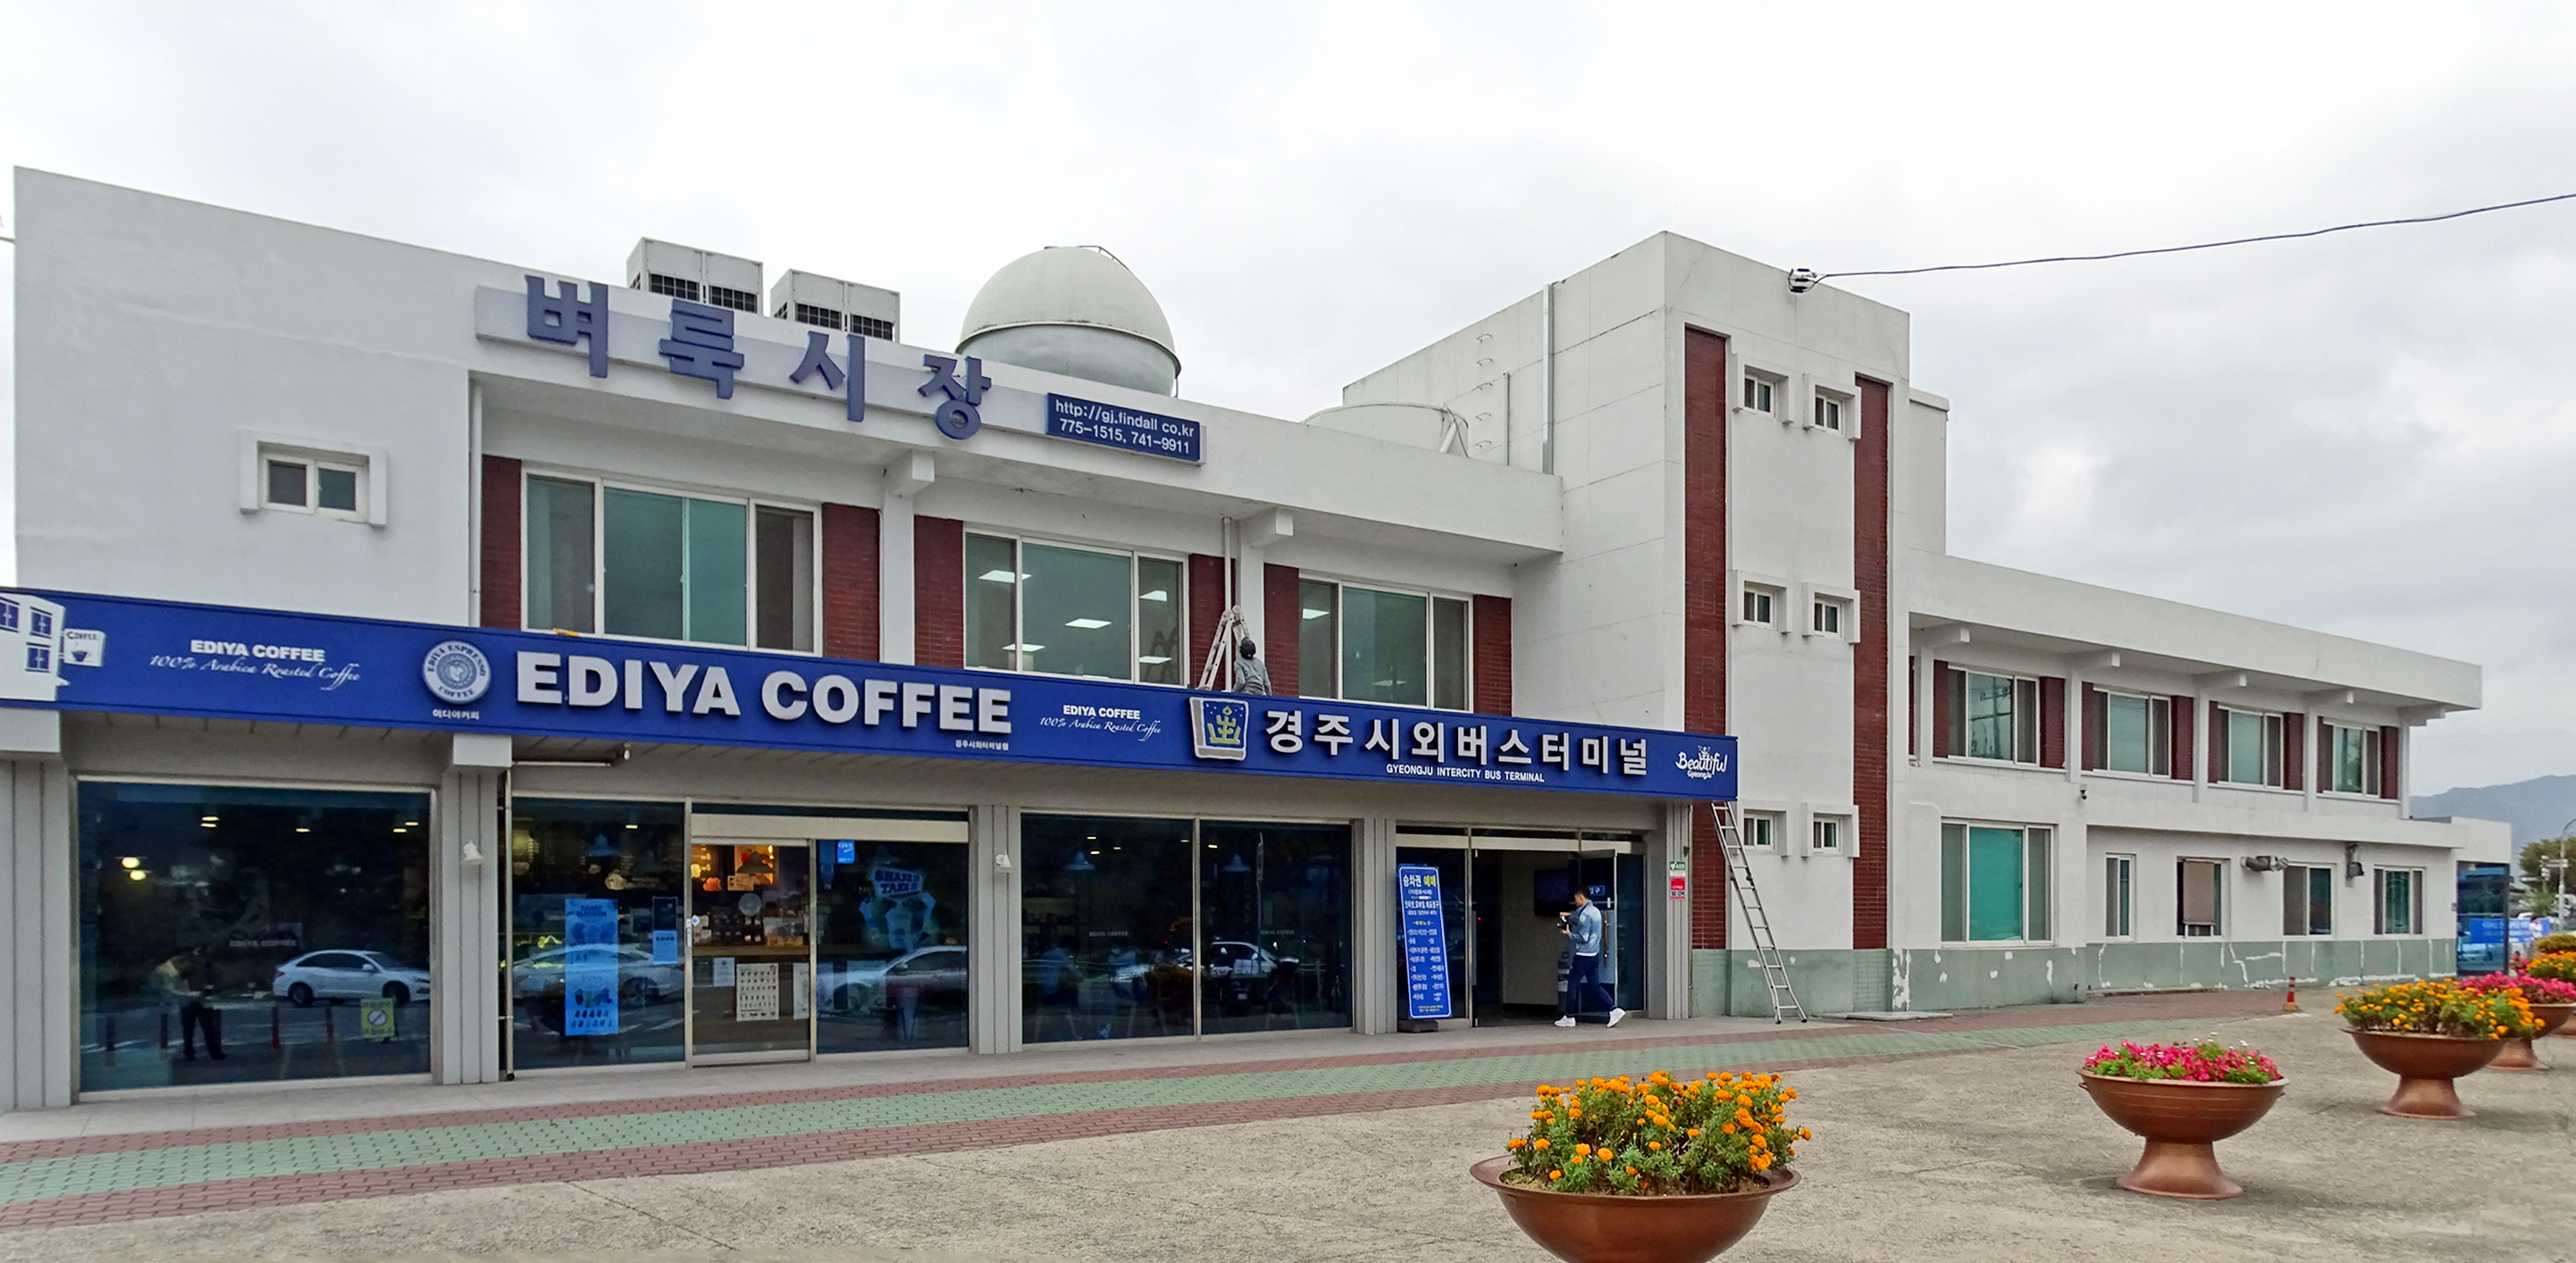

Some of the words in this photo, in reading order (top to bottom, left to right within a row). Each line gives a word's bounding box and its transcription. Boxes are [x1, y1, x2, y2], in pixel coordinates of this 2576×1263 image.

[524, 275, 992, 439] 벼룩시장
[1060, 418, 1127, 444] 775-1515,
[1131, 431, 1189, 454] 741-9911
[190, 640, 249, 657] EDIYA
[252, 644, 325, 662] COFFEE
[150, 655, 197, 670] 100%
[200, 657, 256, 673] Arabica
[262, 662, 323, 679] Roasted
[318, 663, 360, 690] Coffee
[438, 686, 475, 698] COFFEE
[516, 650, 742, 715] EDIYA
[760, 669, 1012, 734] COFFEE
[1063, 705, 1096, 716] EDIYA
[1098, 707, 1141, 720] COFFEE
[1040, 716, 1067, 727] 100%
[1069, 717, 1101, 730] Arabica
[1104, 720, 1138, 732] Roasted
[1137, 720, 1162, 741] Coffee
[1264, 709, 1648, 776] 경주시외버스터미널
[1386, 764, 1433, 776] GYEONGJU
[1437, 767, 1481, 779] INTERCITY
[1484, 770, 1501, 780] BUS
[1505, 771, 1545, 782] TERMINAL
[1675, 748, 1728, 775] Beautiful
[1403, 874, 1422, 887] 승차권
